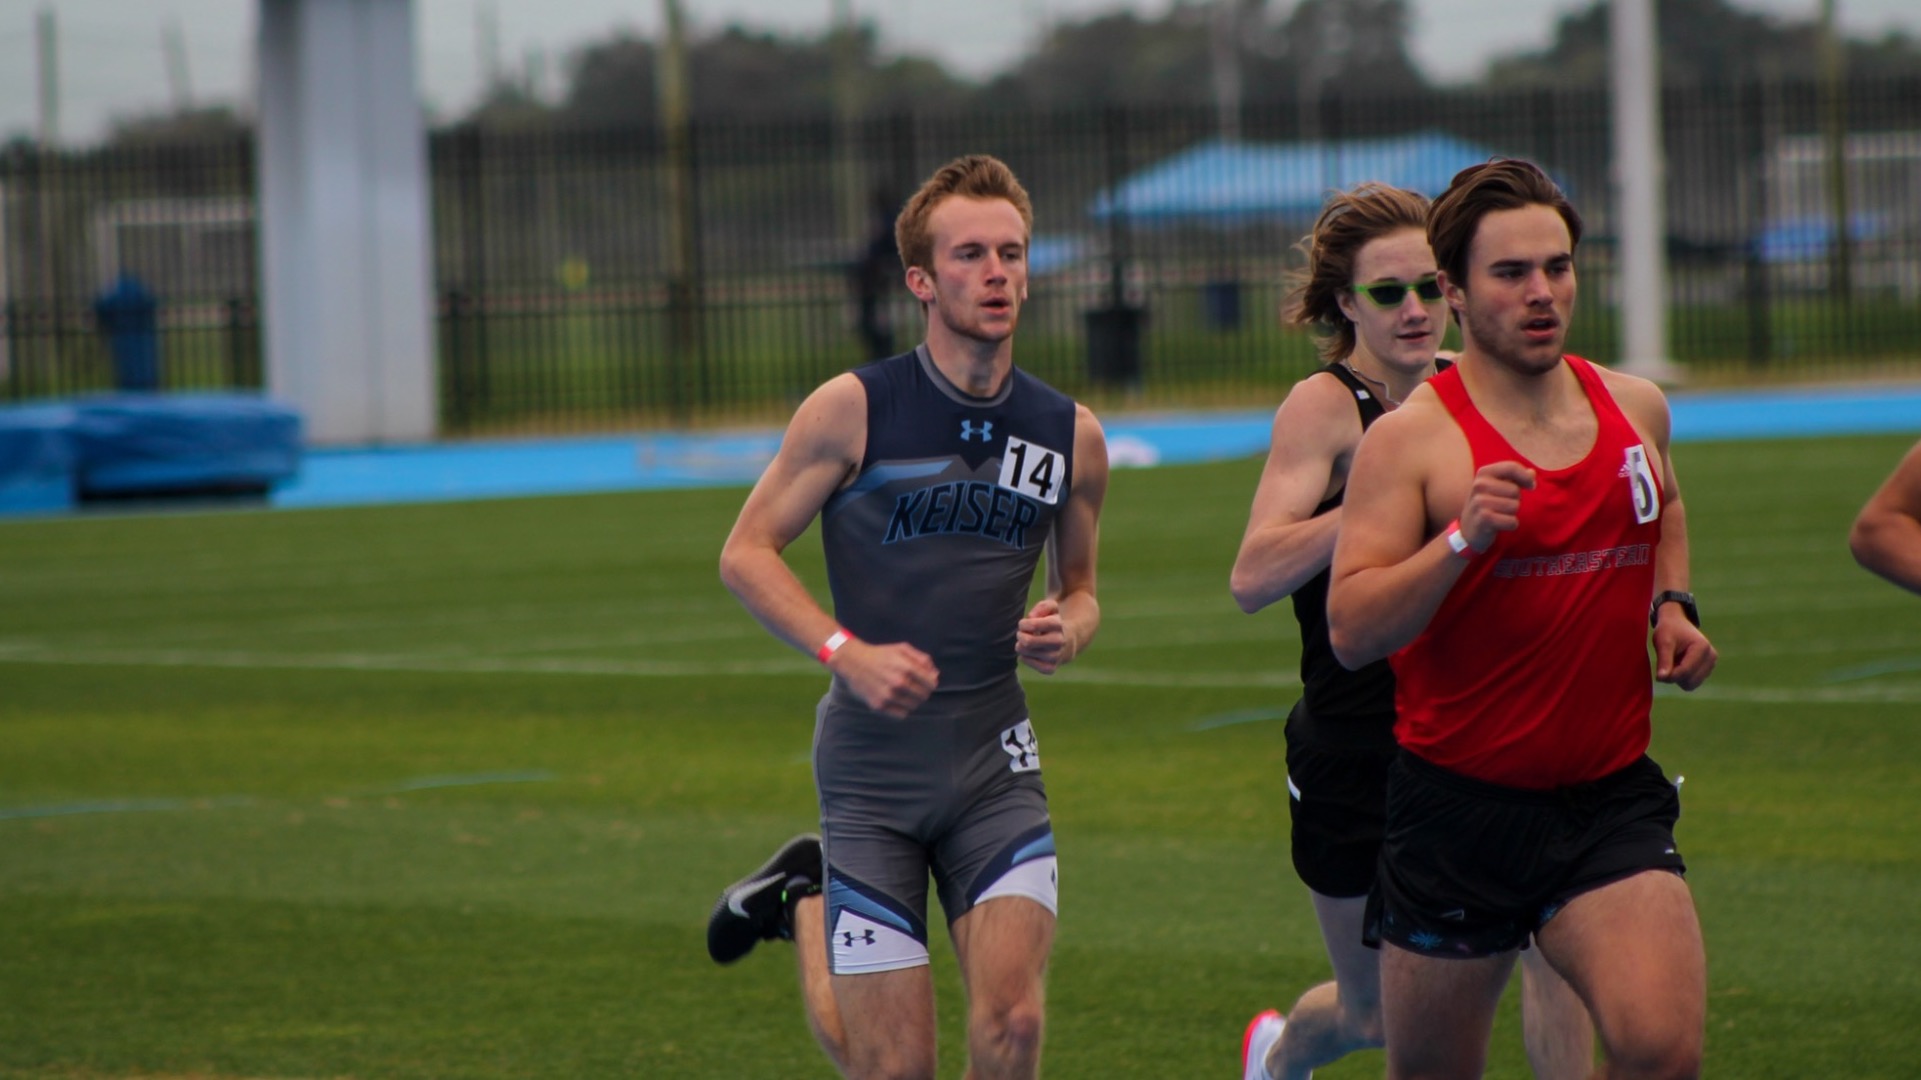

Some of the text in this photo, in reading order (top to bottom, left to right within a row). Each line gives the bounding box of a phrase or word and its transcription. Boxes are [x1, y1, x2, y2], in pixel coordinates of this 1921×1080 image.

[1009, 443, 1055, 498] 14
[1632, 450, 1654, 517] 5
[882, 481, 1038, 549] KEISER
